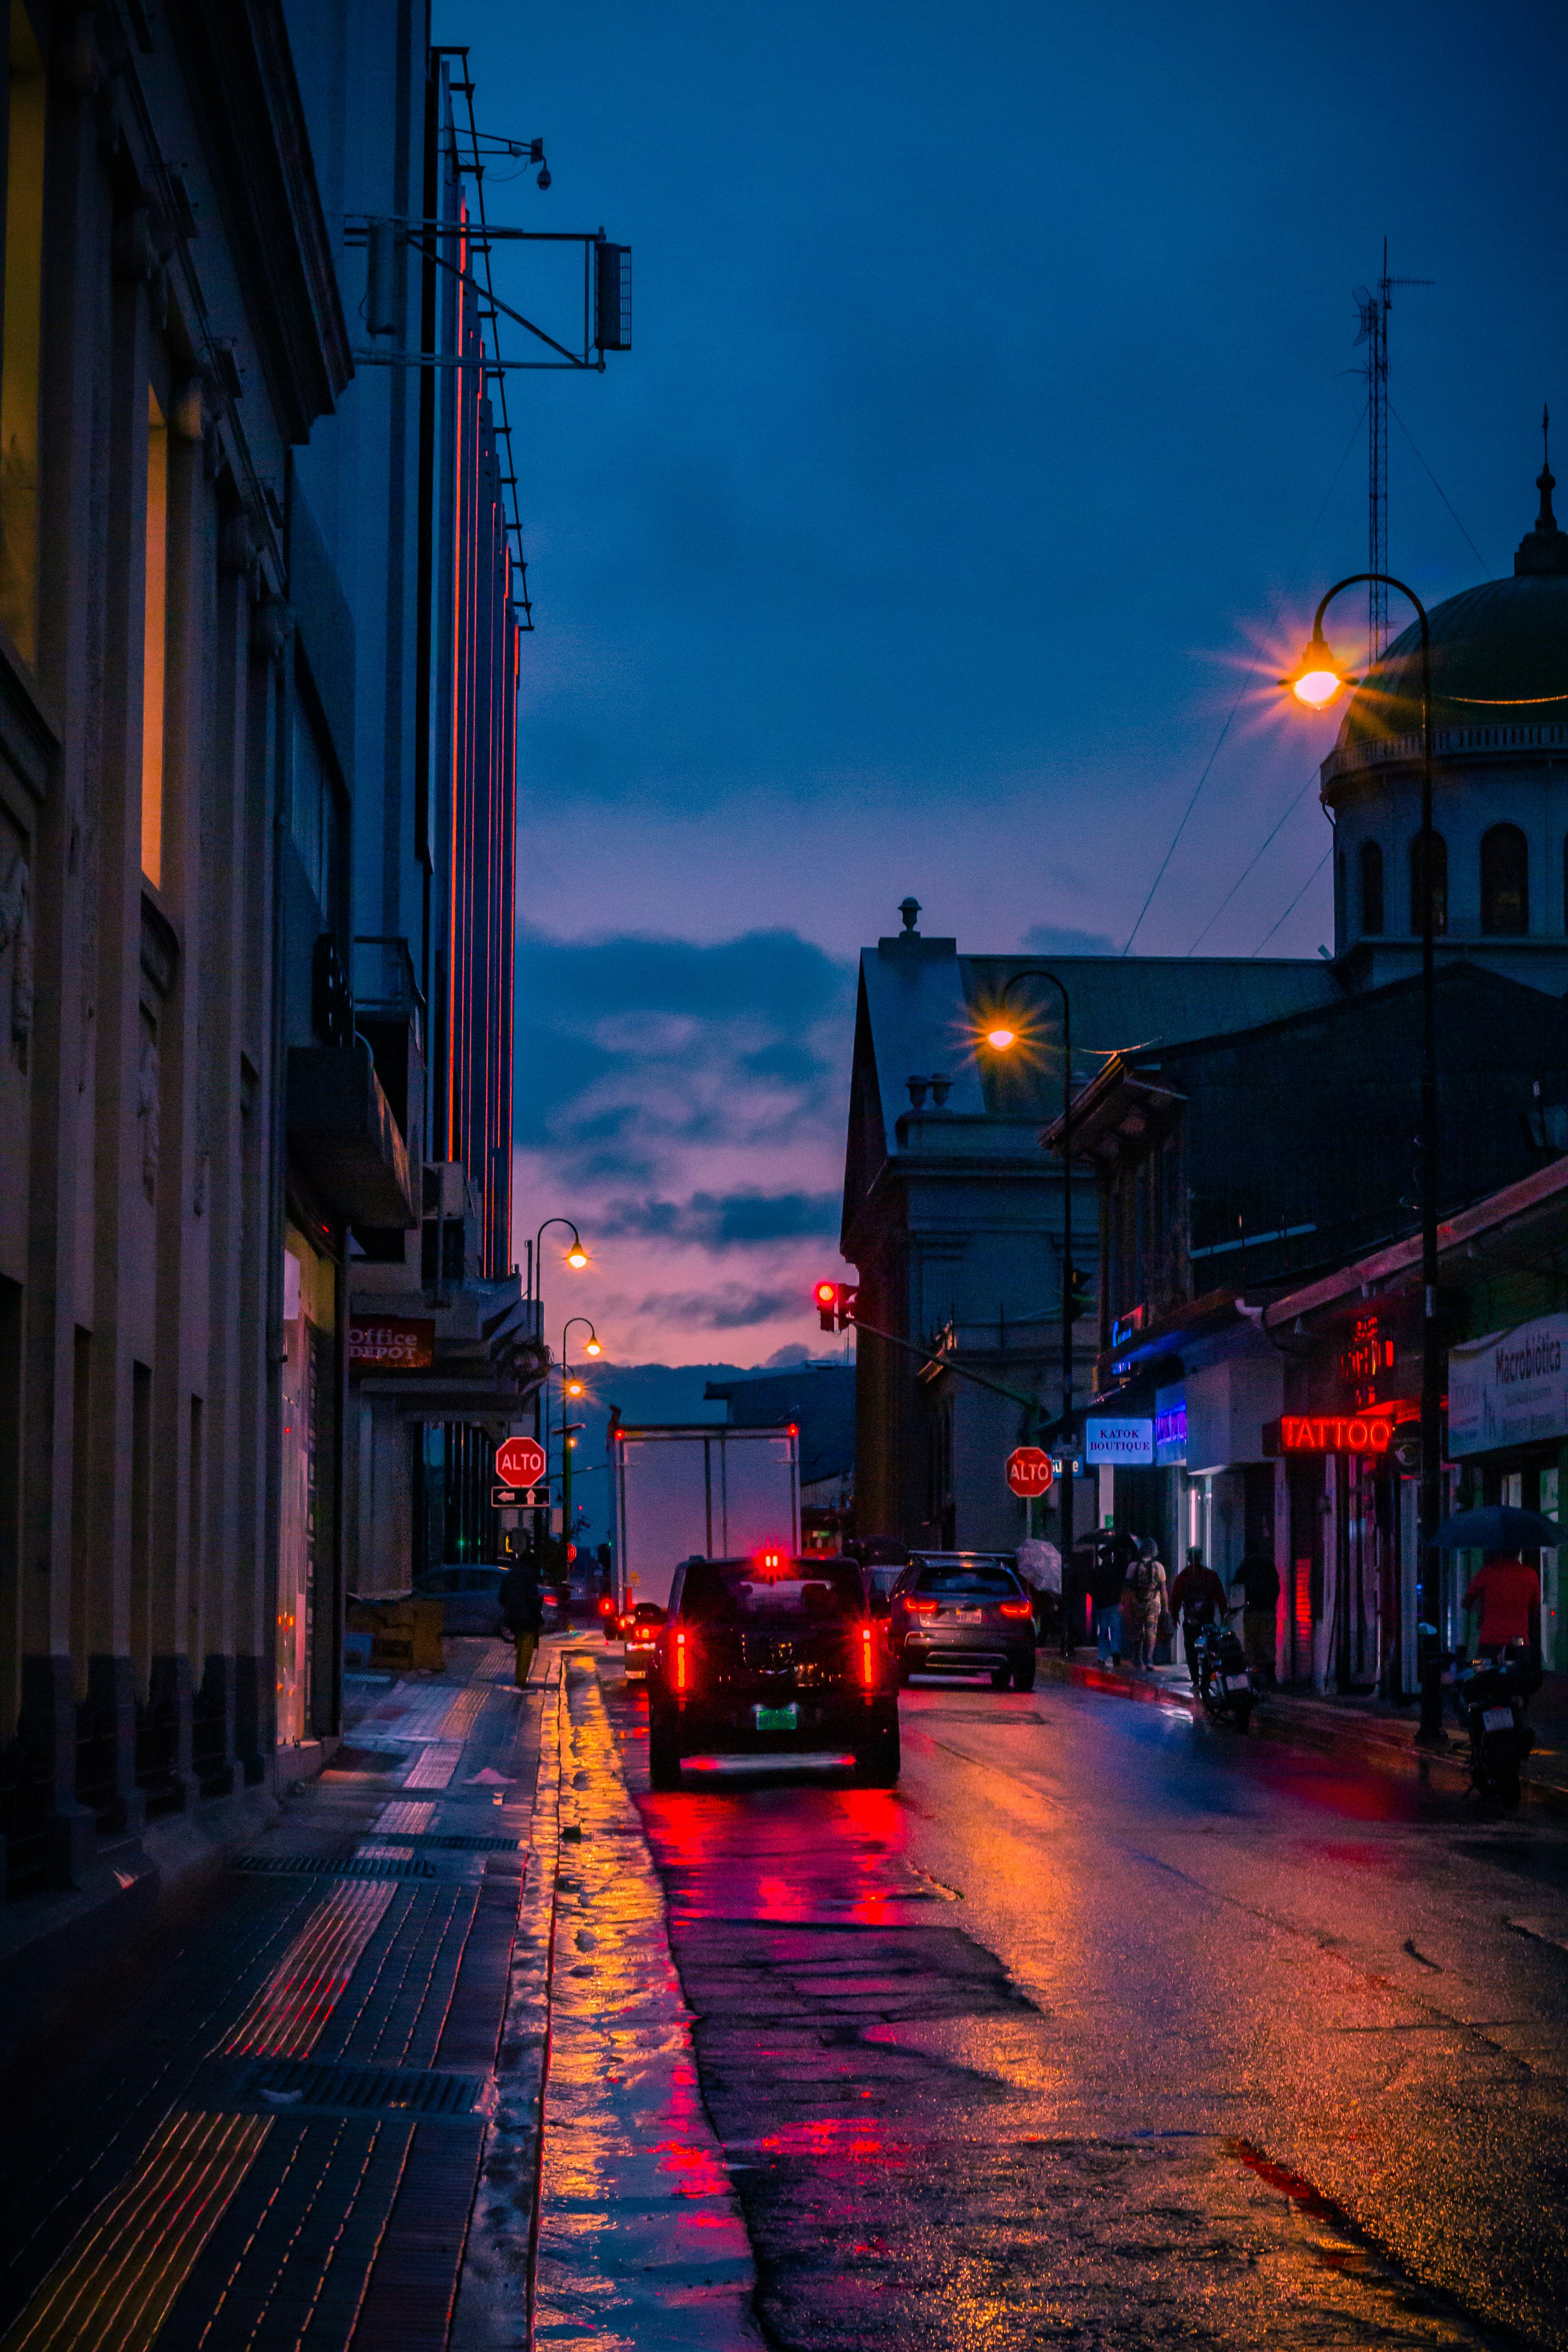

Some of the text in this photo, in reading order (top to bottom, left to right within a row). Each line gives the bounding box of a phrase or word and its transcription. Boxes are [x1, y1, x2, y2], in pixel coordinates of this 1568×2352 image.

[349, 1328, 417, 1346] Office
[349, 1346, 416, 1359] DEPOT
[1100, 1430, 1139, 1439] KATOK
[1282, 1419, 1392, 1449] TATTOO
[1090, 1441, 1150, 1452] BOUTIQUE
[501, 1453, 541, 1471] ALTO
[1010, 1463, 1049, 1480] ALTO
